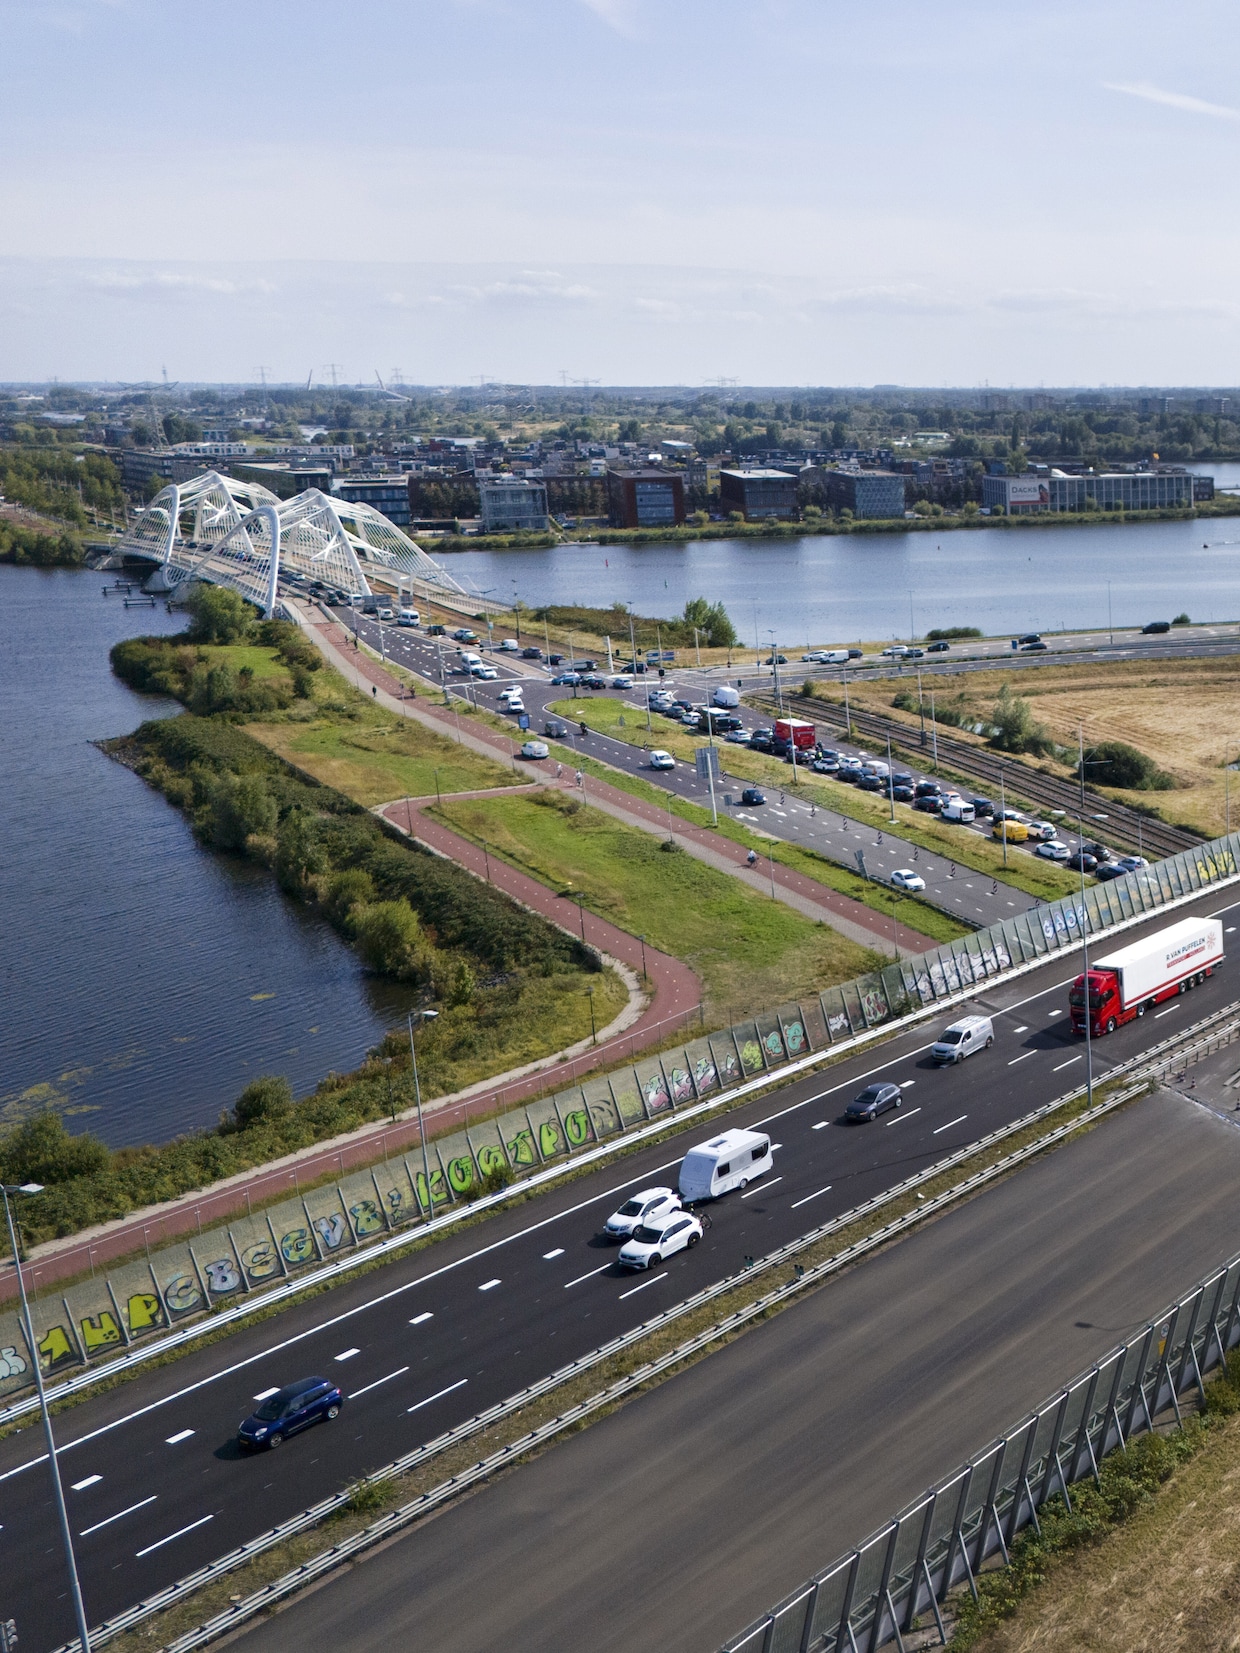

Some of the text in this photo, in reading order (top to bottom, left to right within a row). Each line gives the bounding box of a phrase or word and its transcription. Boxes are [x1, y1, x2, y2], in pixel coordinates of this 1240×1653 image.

[1011, 486, 1038, 494] DACKS
[1170, 948, 1182, 959] VAN
[1182, 937, 1206, 953] PUFFELEN
